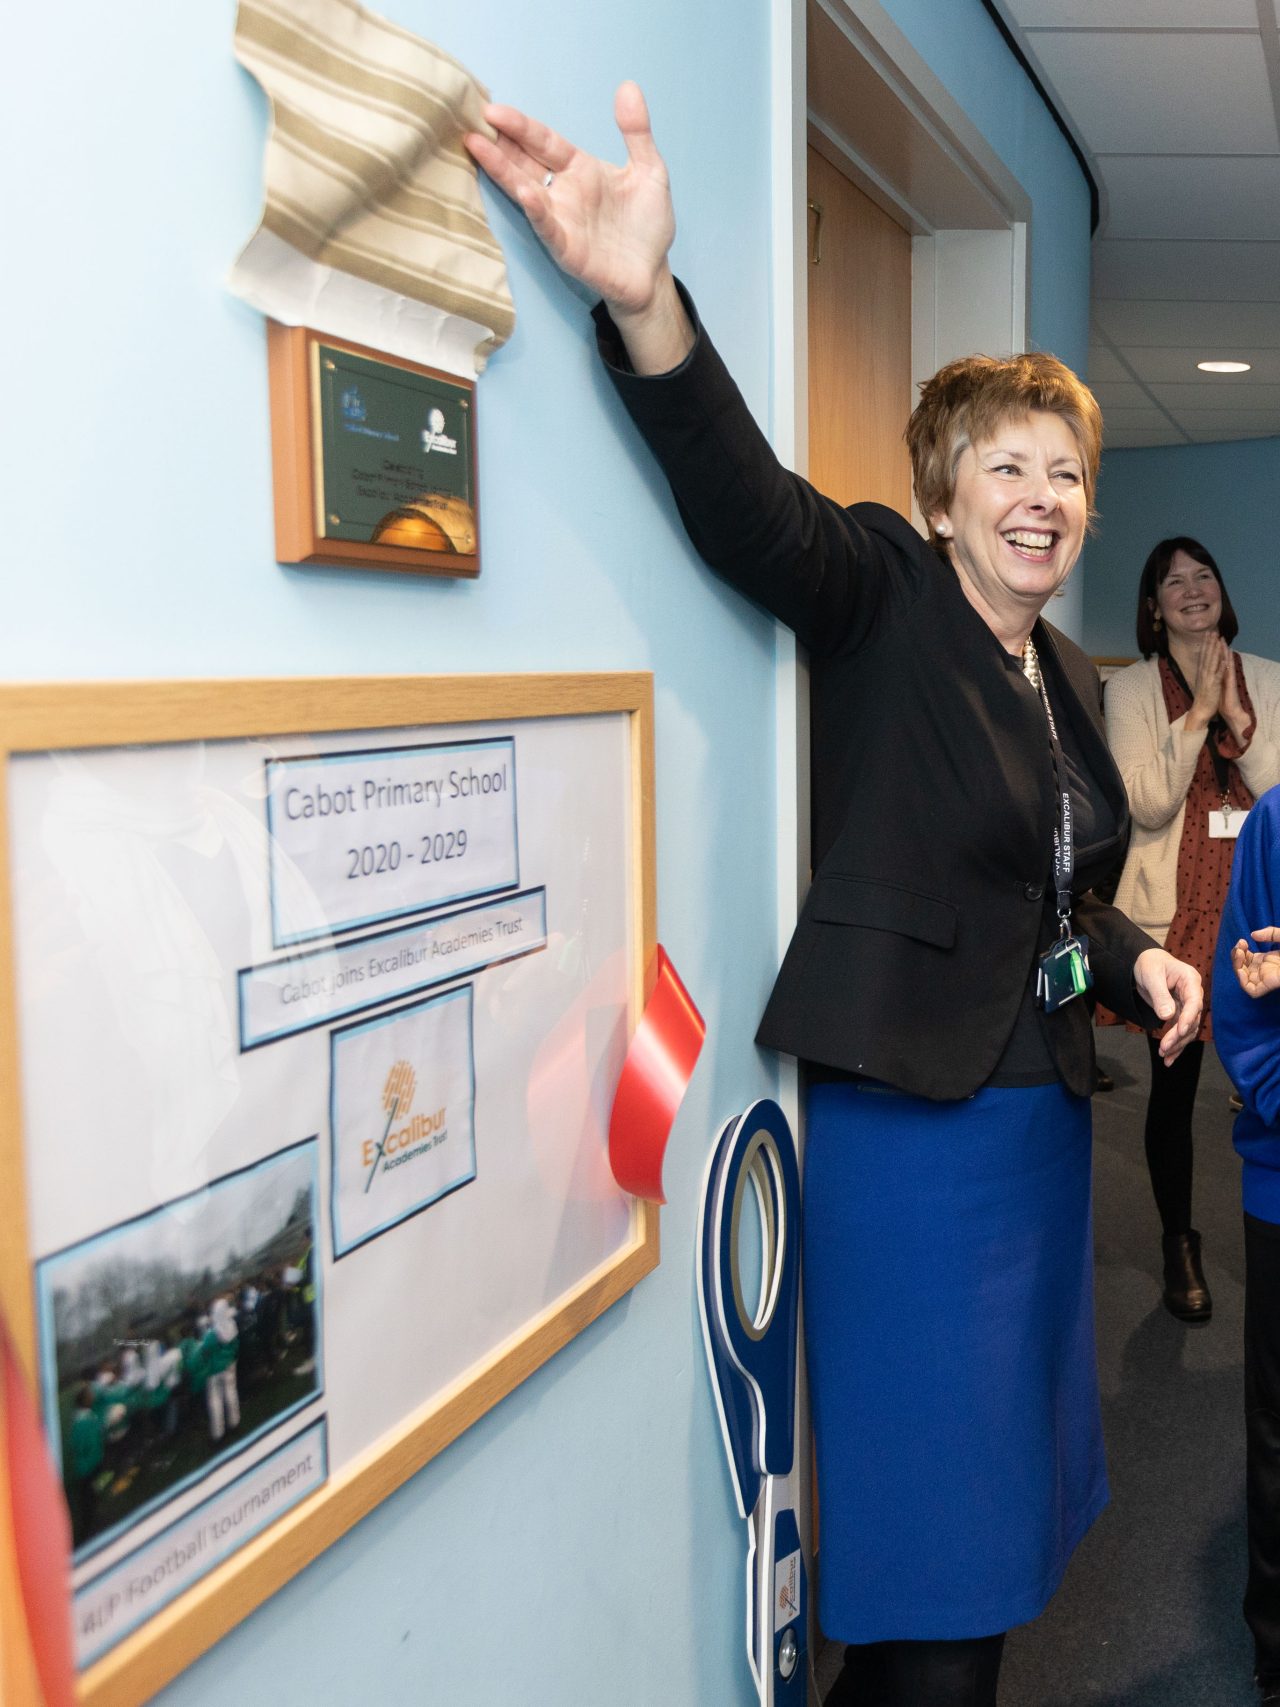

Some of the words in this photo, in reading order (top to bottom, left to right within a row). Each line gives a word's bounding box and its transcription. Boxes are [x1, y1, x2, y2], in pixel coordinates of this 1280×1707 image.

[286, 783, 357, 821] Cabot
[364, 777, 444, 809] Primary
[450, 763, 507, 799] School
[1062, 792, 1071, 843] EXCALIBUR
[347, 841, 401, 880] 2020
[420, 829, 468, 865] 2029
[1063, 845, 1071, 873] STAFF
[280, 977, 327, 1005] Cabot
[331, 966, 364, 997] joins
[368, 943, 428, 978] Excalibur
[432, 927, 494, 959] Academies
[495, 917, 523, 938] Trust
[362, 1106, 447, 1169] Excalibur
[382, 1142, 433, 1173] Academies
[124, 1527, 209, 1605] Football
[209, 1454, 314, 1541] tournament
